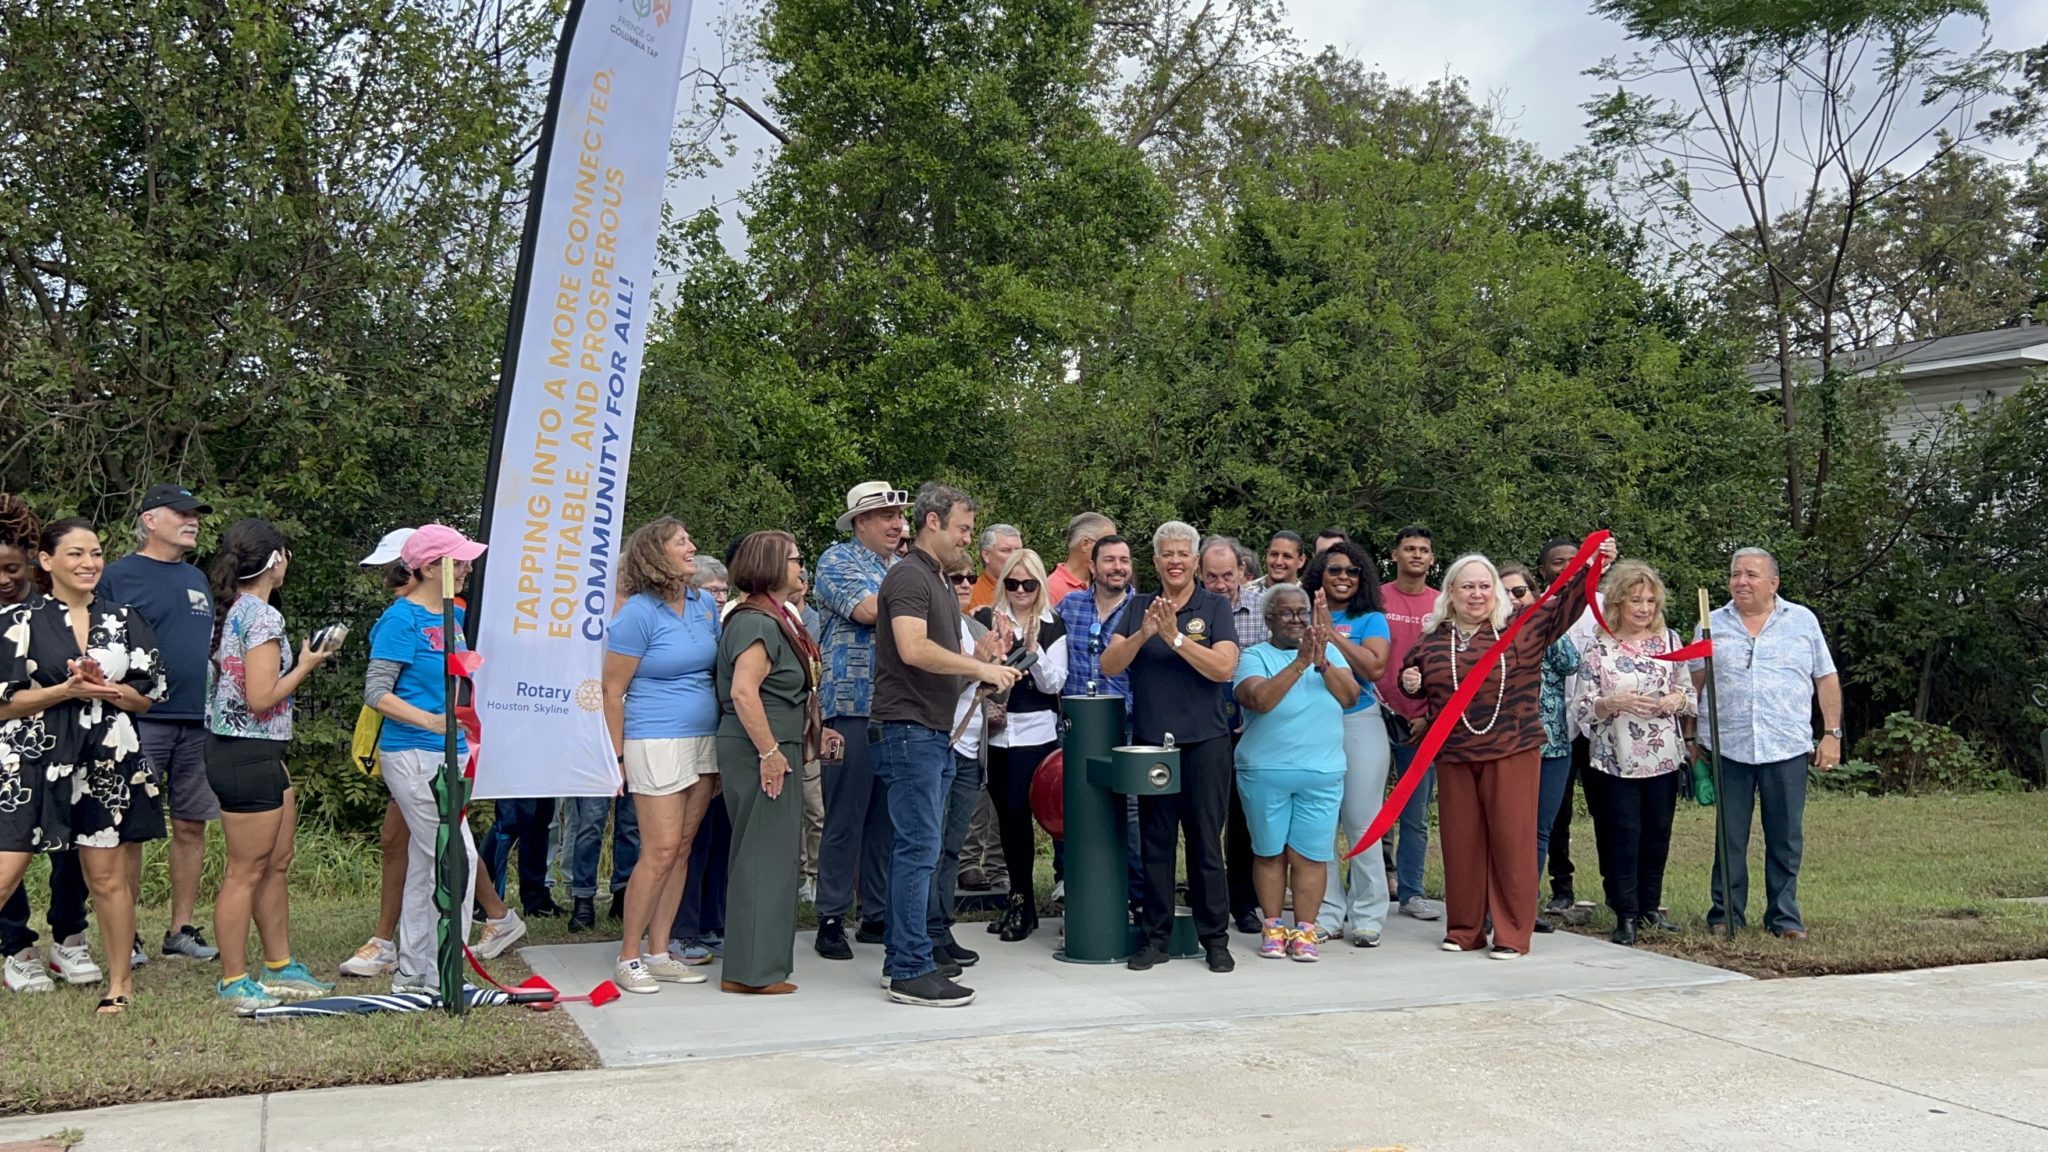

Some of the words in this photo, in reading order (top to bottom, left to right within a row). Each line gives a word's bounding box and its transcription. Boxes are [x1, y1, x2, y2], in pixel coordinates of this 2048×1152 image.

[610, 24, 645, 53] COLUMBIA
[646, 46, 658, 58] TAP
[618, 15, 645, 38] FRIENDS
[645, 33, 655, 43] OF
[564, 68, 616, 267] CONNECTED,
[580, 166, 625, 373] PROSPEROUS
[548, 274, 582, 369] MORE
[614, 275, 635, 344] ALL!
[543, 378, 568, 401] A
[570, 380, 599, 452] AND
[606, 350, 628, 417] FOR
[530, 407, 563, 486] INTO
[513, 493, 552, 635] TAPPING
[548, 462, 595, 639] EQUITABLE,
[581, 422, 620, 642] COMMUNITY
[1385, 613, 1420, 624] otaract
[487, 700, 530, 712] Houston
[534, 703, 570, 715] Skyline
[516, 681, 572, 702] Rotary
